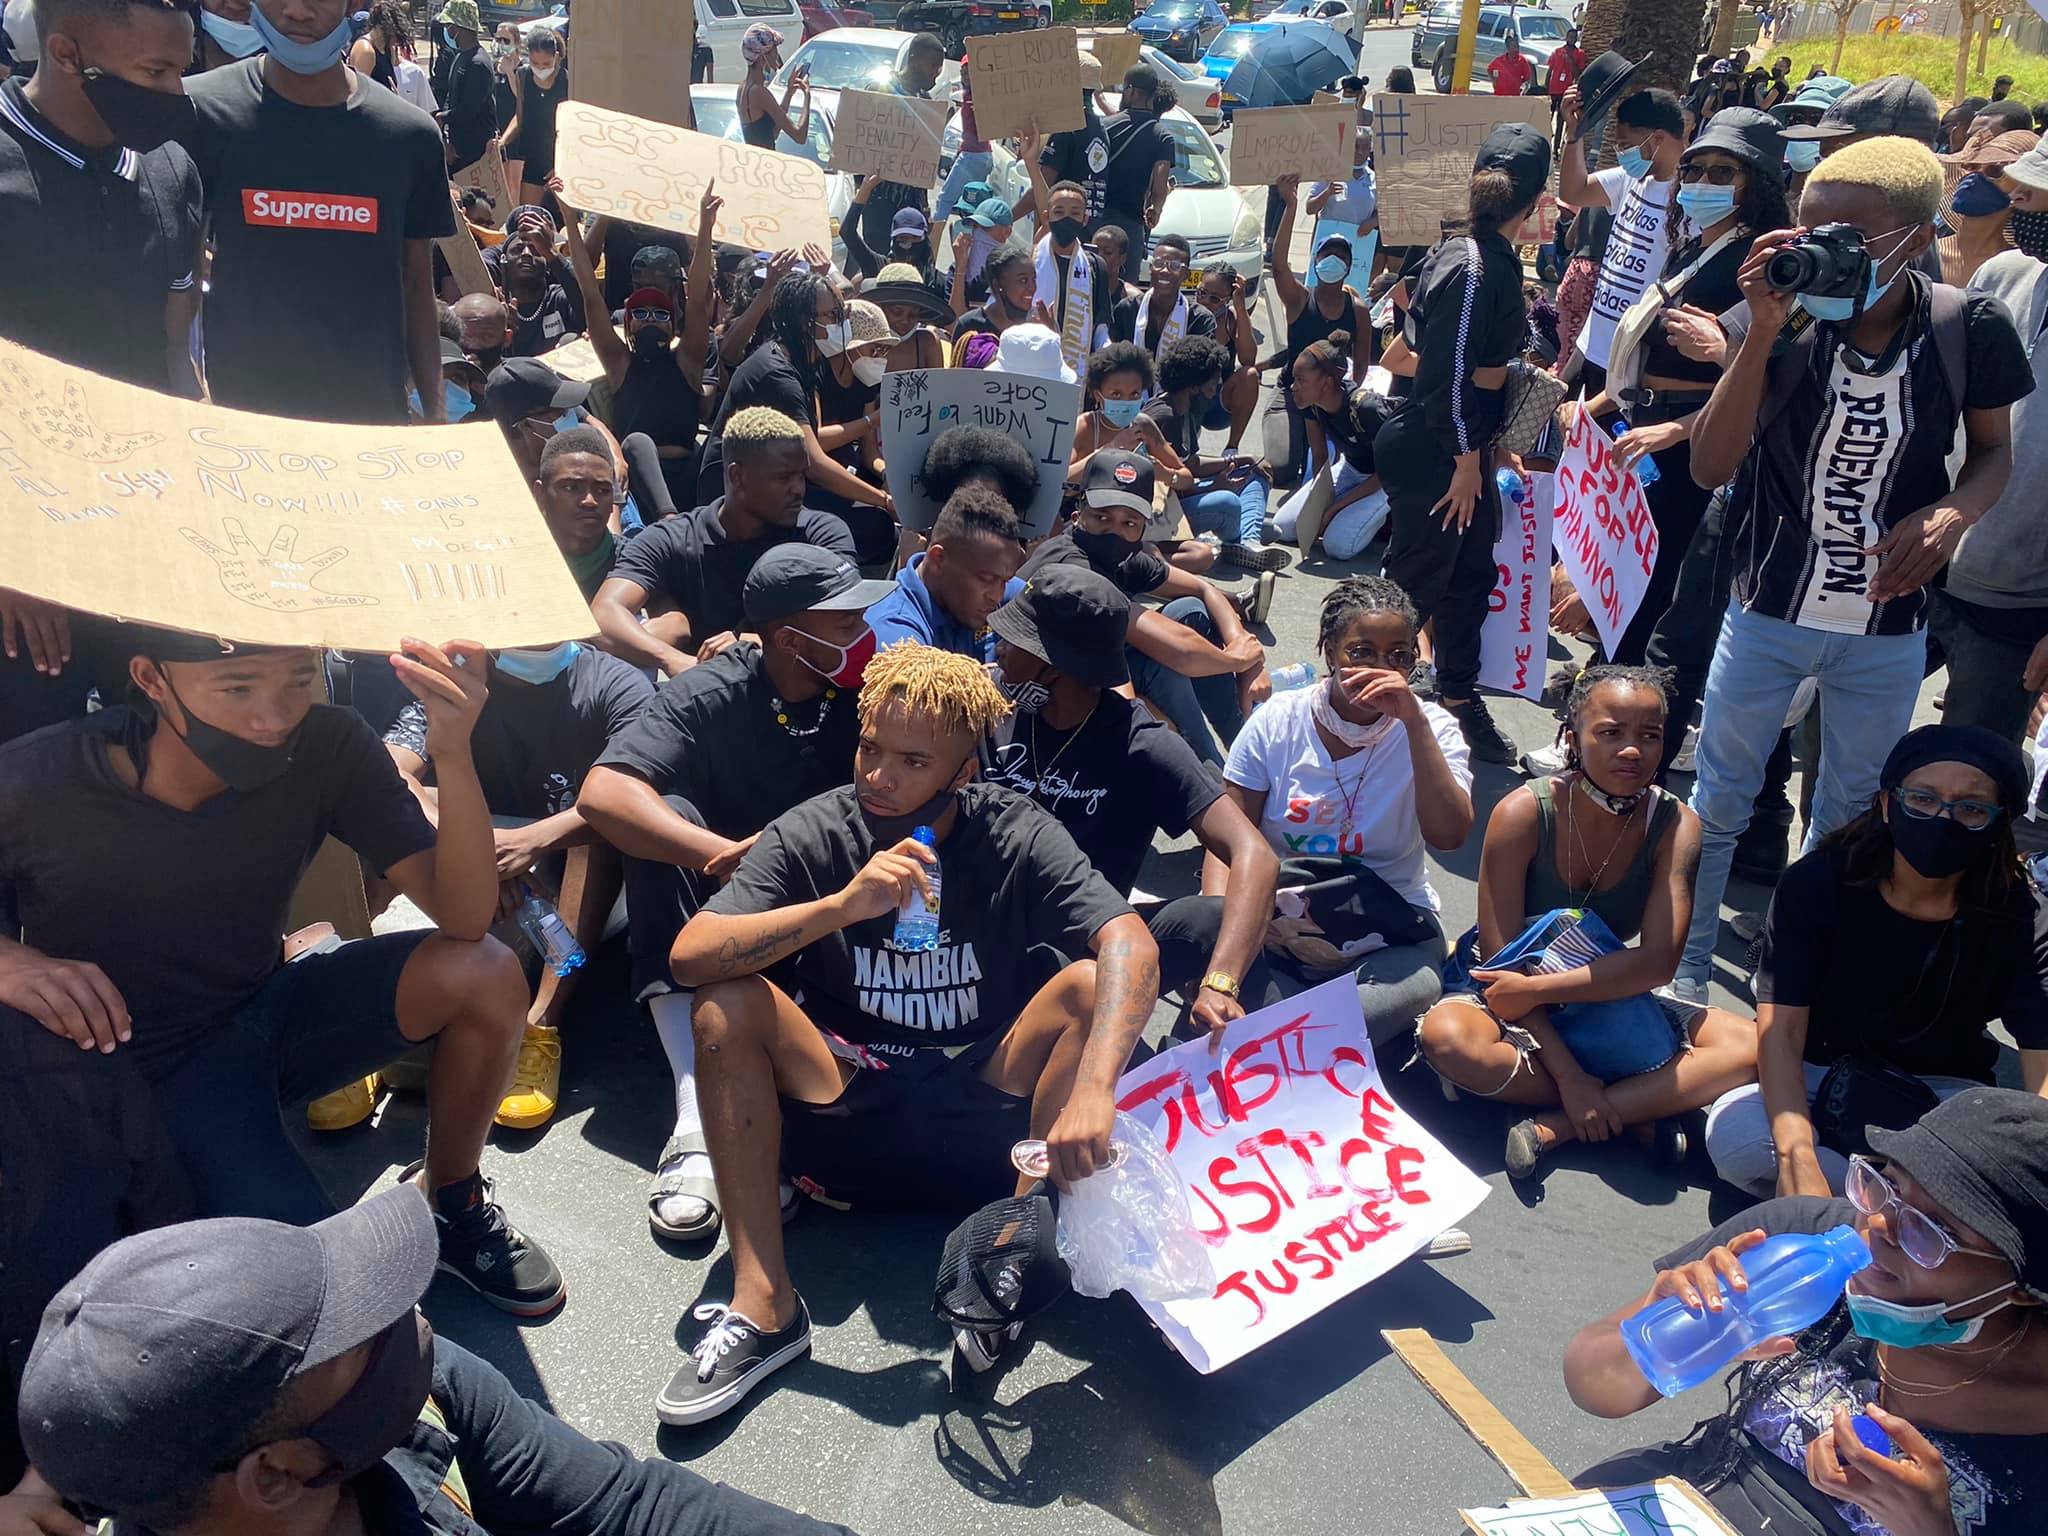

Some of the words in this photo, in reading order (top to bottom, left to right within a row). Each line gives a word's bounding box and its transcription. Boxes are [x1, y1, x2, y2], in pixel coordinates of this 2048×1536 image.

[855, 94, 916, 128] DEATH
[855, 123, 921, 152] PENALTY
[718, 144, 825, 200] HAS
[252, 191, 371, 225] Supreme
[1040, 416, 1070, 465] I
[1552, 464, 1624, 632] SHANNON
[1518, 572, 1534, 633] WANT
[1511, 644, 1532, 690] WE
[1281, 831, 1365, 856] YOU
[853, 941, 984, 991] NAMIBIA
[1190, 1127, 1432, 1249] USTICE
[1212, 1199, 1405, 1329] JUSTICE
